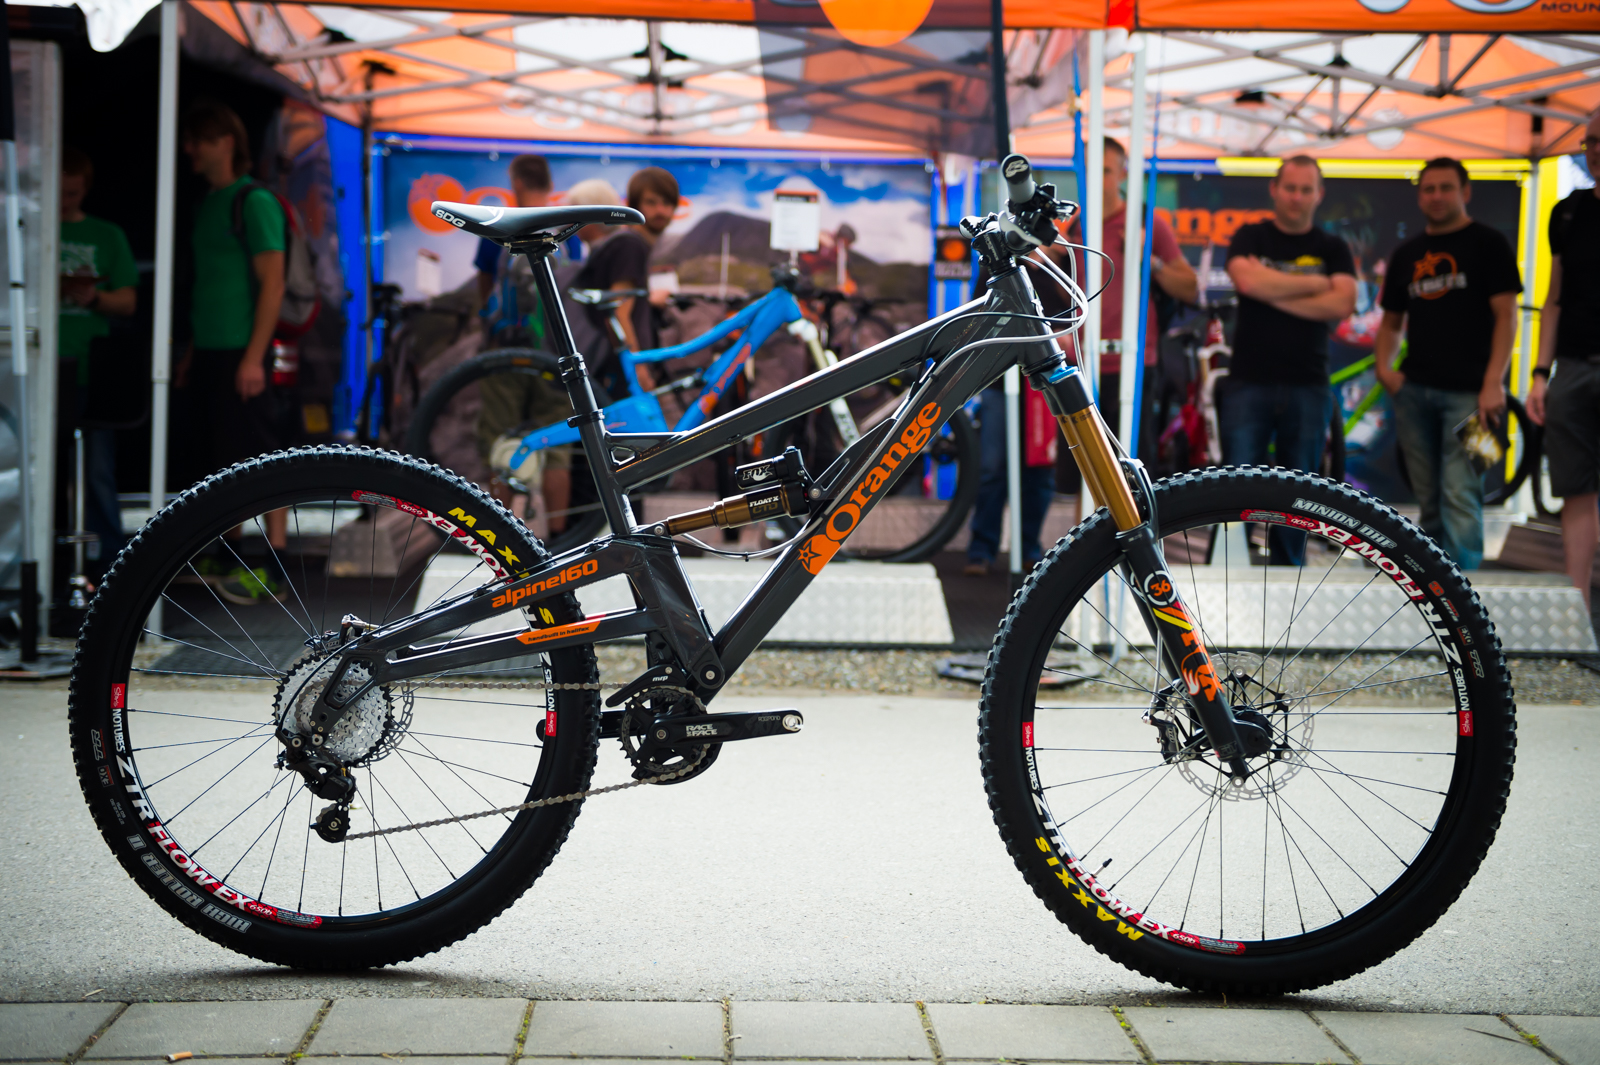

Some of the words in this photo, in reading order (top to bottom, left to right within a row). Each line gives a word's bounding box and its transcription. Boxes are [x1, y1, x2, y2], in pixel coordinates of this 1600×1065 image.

[435, 209, 466, 228] SDG
[742, 464, 773, 481] FOX
[826, 402, 942, 542] Orange
[421, 509, 459, 535] EX
[749, 498, 773, 508] FLOAT
[1292, 498, 1361, 529] MINION
[1357, 524, 1398, 549] DHF
[1312, 520, 1353, 544] EX
[491, 559, 599, 608] alpine160
[1150, 579, 1172, 597] 36
[1350, 541, 1424, 598] FLOW
[1428, 581, 1445, 597] 3C
[528, 632, 559, 642] handbuilt
[1418, 601, 1463, 665] ZTR
[1453, 667, 1470, 711] NOTUBES
[112, 708, 126, 753] NOTUBES
[685, 723, 714, 731] RACE
[692, 728, 718, 737] FACE
[116, 754, 154, 821] ZTR
[1025, 746, 1040, 791] NOTUBES
[1031, 792, 1071, 858] ZTR
[148, 825, 219, 886] FLOW
[141, 852, 205, 909] ROLLER
[213, 884, 254, 911] EX
[1035, 836, 1144, 942] MAXXIS
[1067, 859, 1139, 919] FLOW
[200, 903, 252, 934] HIGH
[1135, 915, 1176, 940] EX
